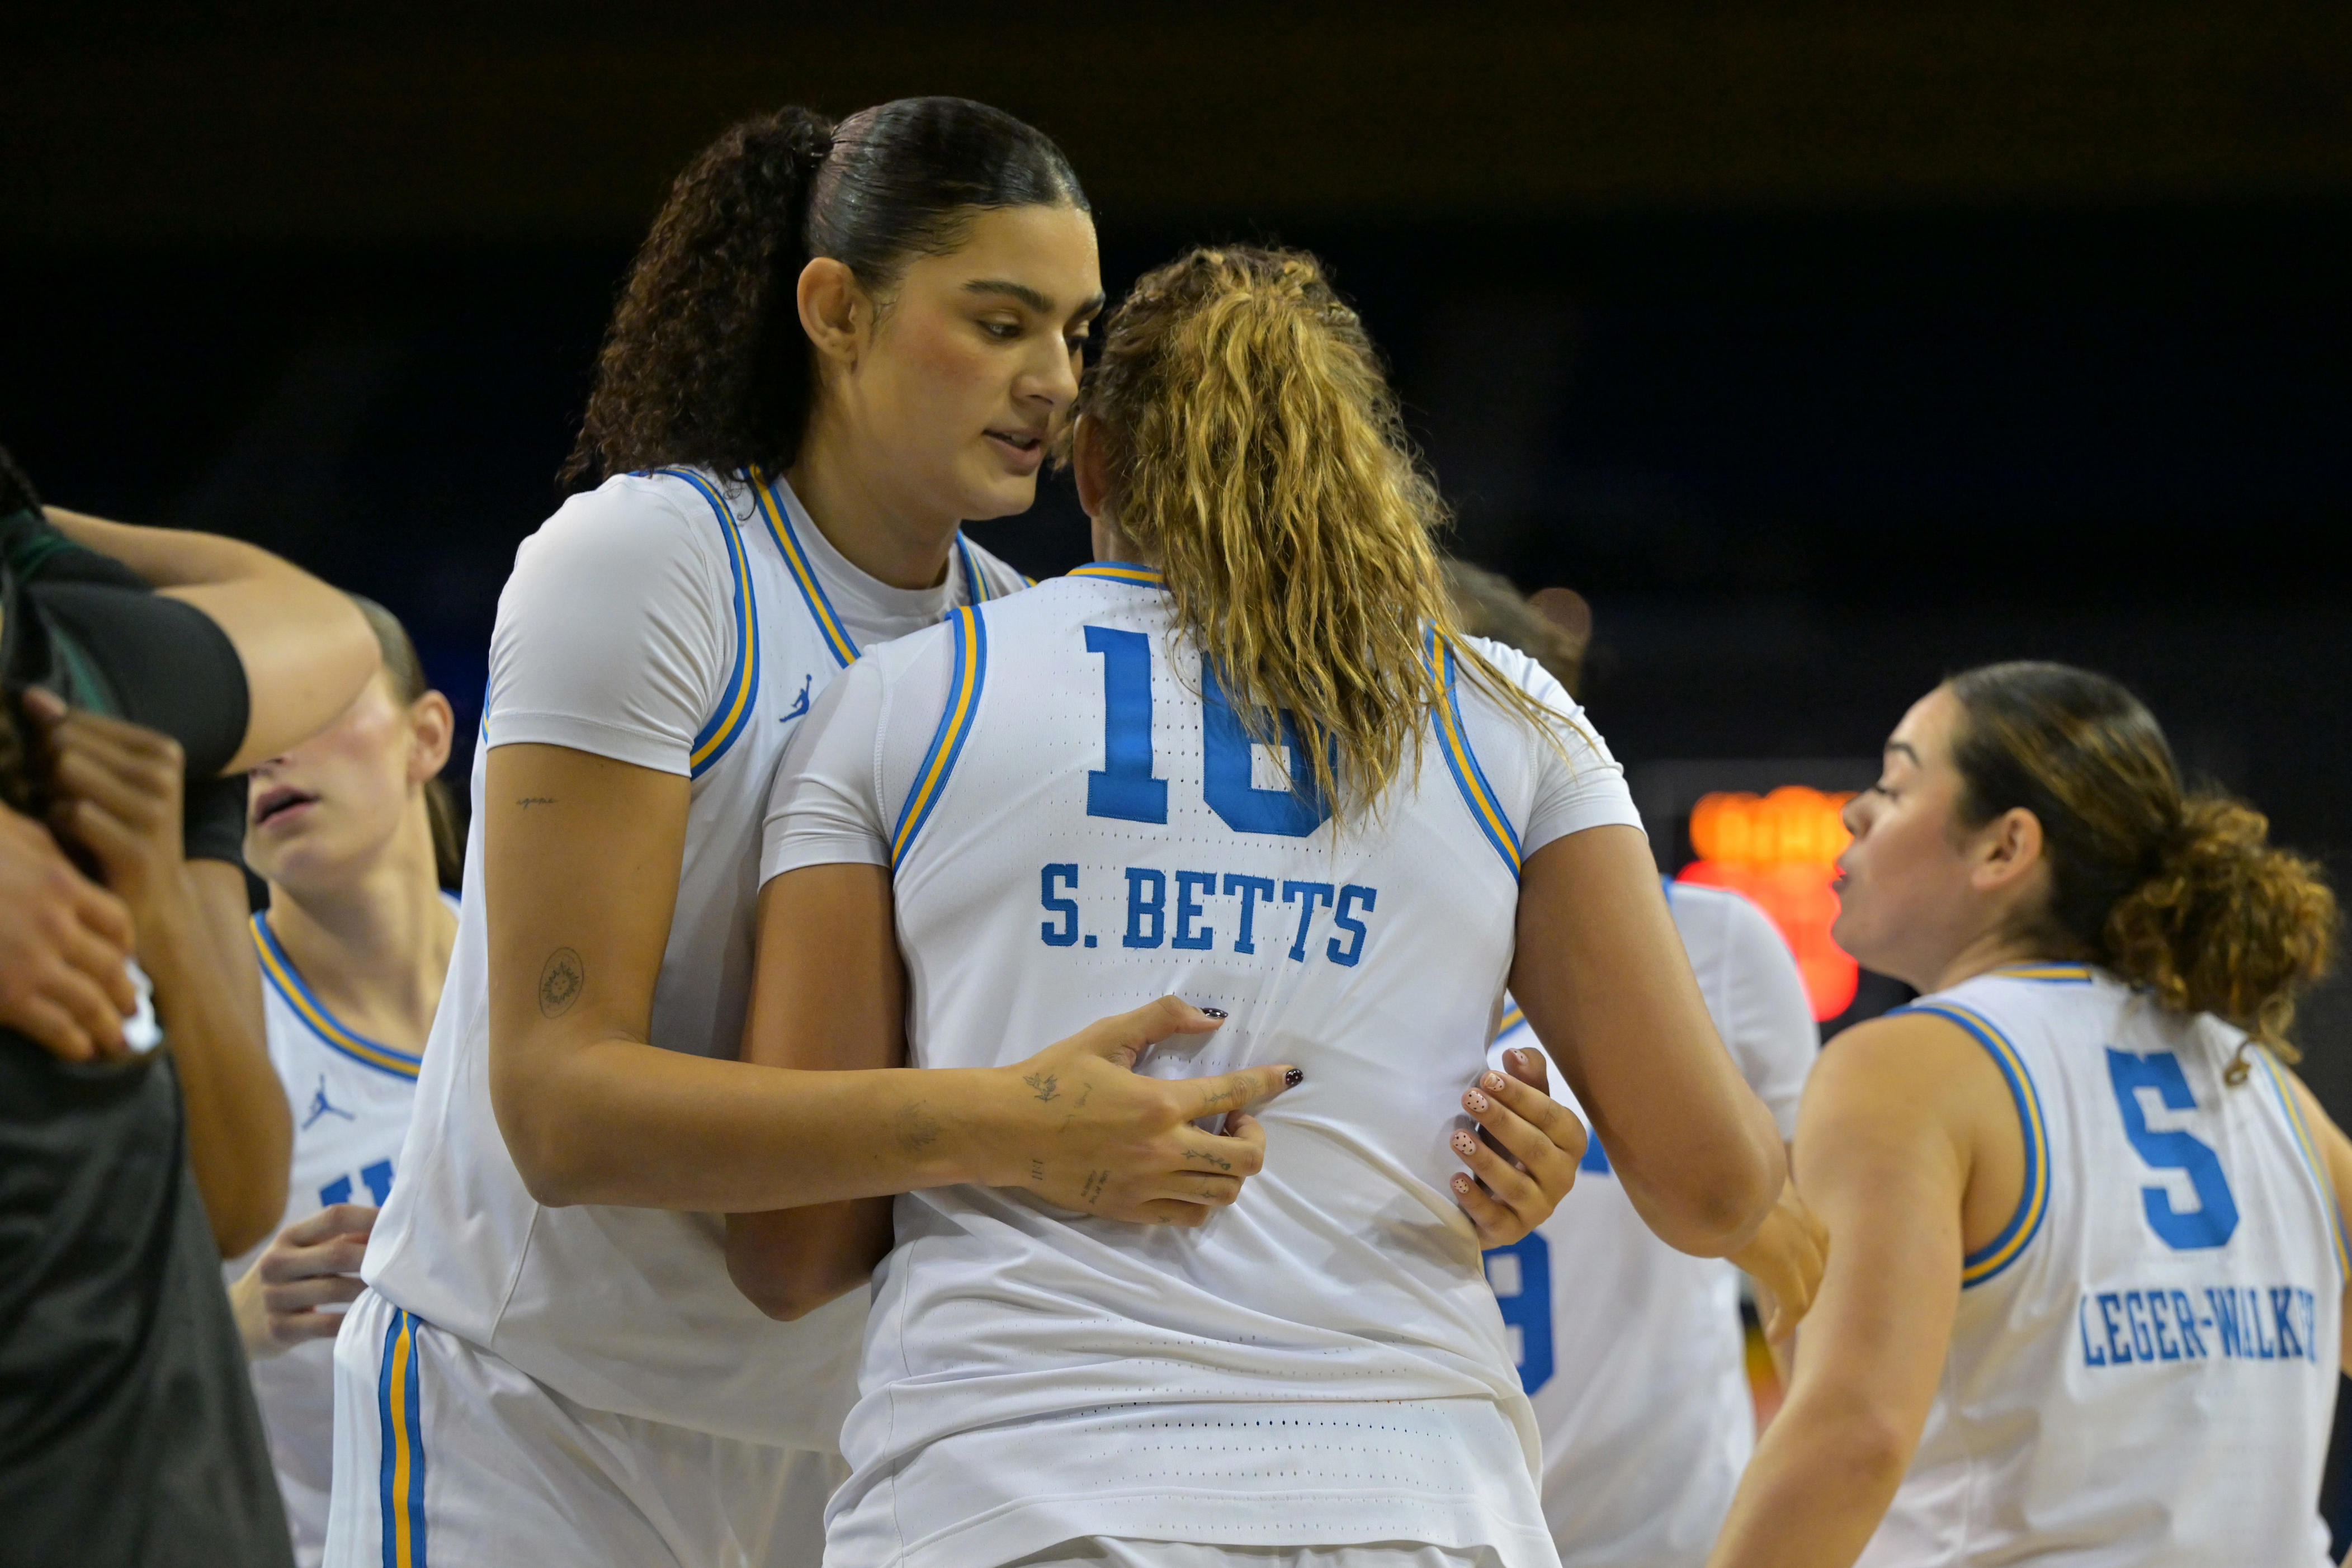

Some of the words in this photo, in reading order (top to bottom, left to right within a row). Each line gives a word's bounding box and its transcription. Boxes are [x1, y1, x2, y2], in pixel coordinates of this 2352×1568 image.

[1041, 863, 1098, 948] S.
[1122, 867, 1377, 967] BETTS
[2105, 1045, 2239, 1250] 5
